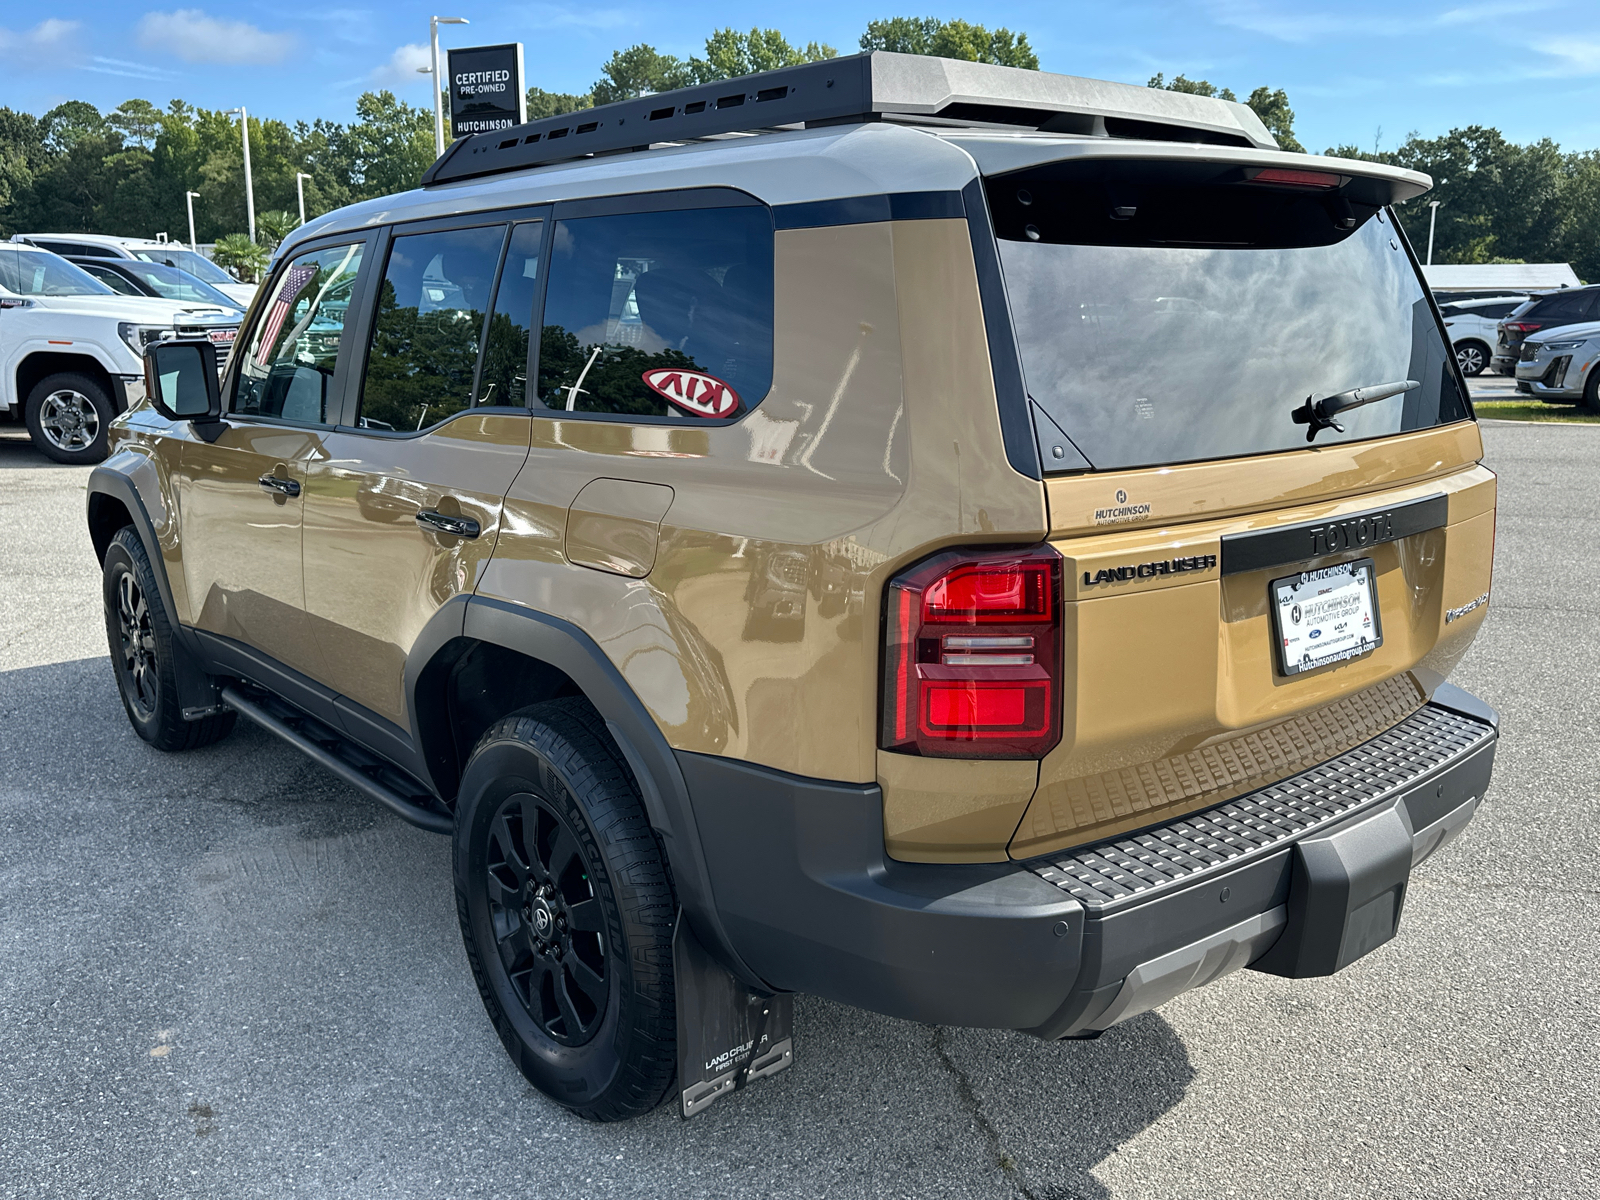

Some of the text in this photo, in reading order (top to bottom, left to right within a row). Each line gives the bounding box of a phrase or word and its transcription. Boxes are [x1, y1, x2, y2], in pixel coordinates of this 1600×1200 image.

[455, 69, 510, 85] CERTIFIED
[460, 83, 506, 95] PRE-OWNED
[457, 118, 513, 132] HUTCHINSON
[1095, 504, 1151, 520] HUTCHINSON
[1096, 514, 1149, 526] AUTOMOTIVE GROUP
[1309, 513, 1395, 555] TOYOTA
[1084, 554, 1217, 586] LAND CRUISER
[1310, 563, 1353, 582] HUTCHINSON
[1304, 592, 1361, 619] HUTCHINSON
[1306, 605, 1360, 627] AUTOMOTIVE GROUP
[1298, 642, 1376, 673] Hutchinsonautogroup.com
[705, 1052, 729, 1070] LAND
[715, 1059, 733, 1072] FIRST
